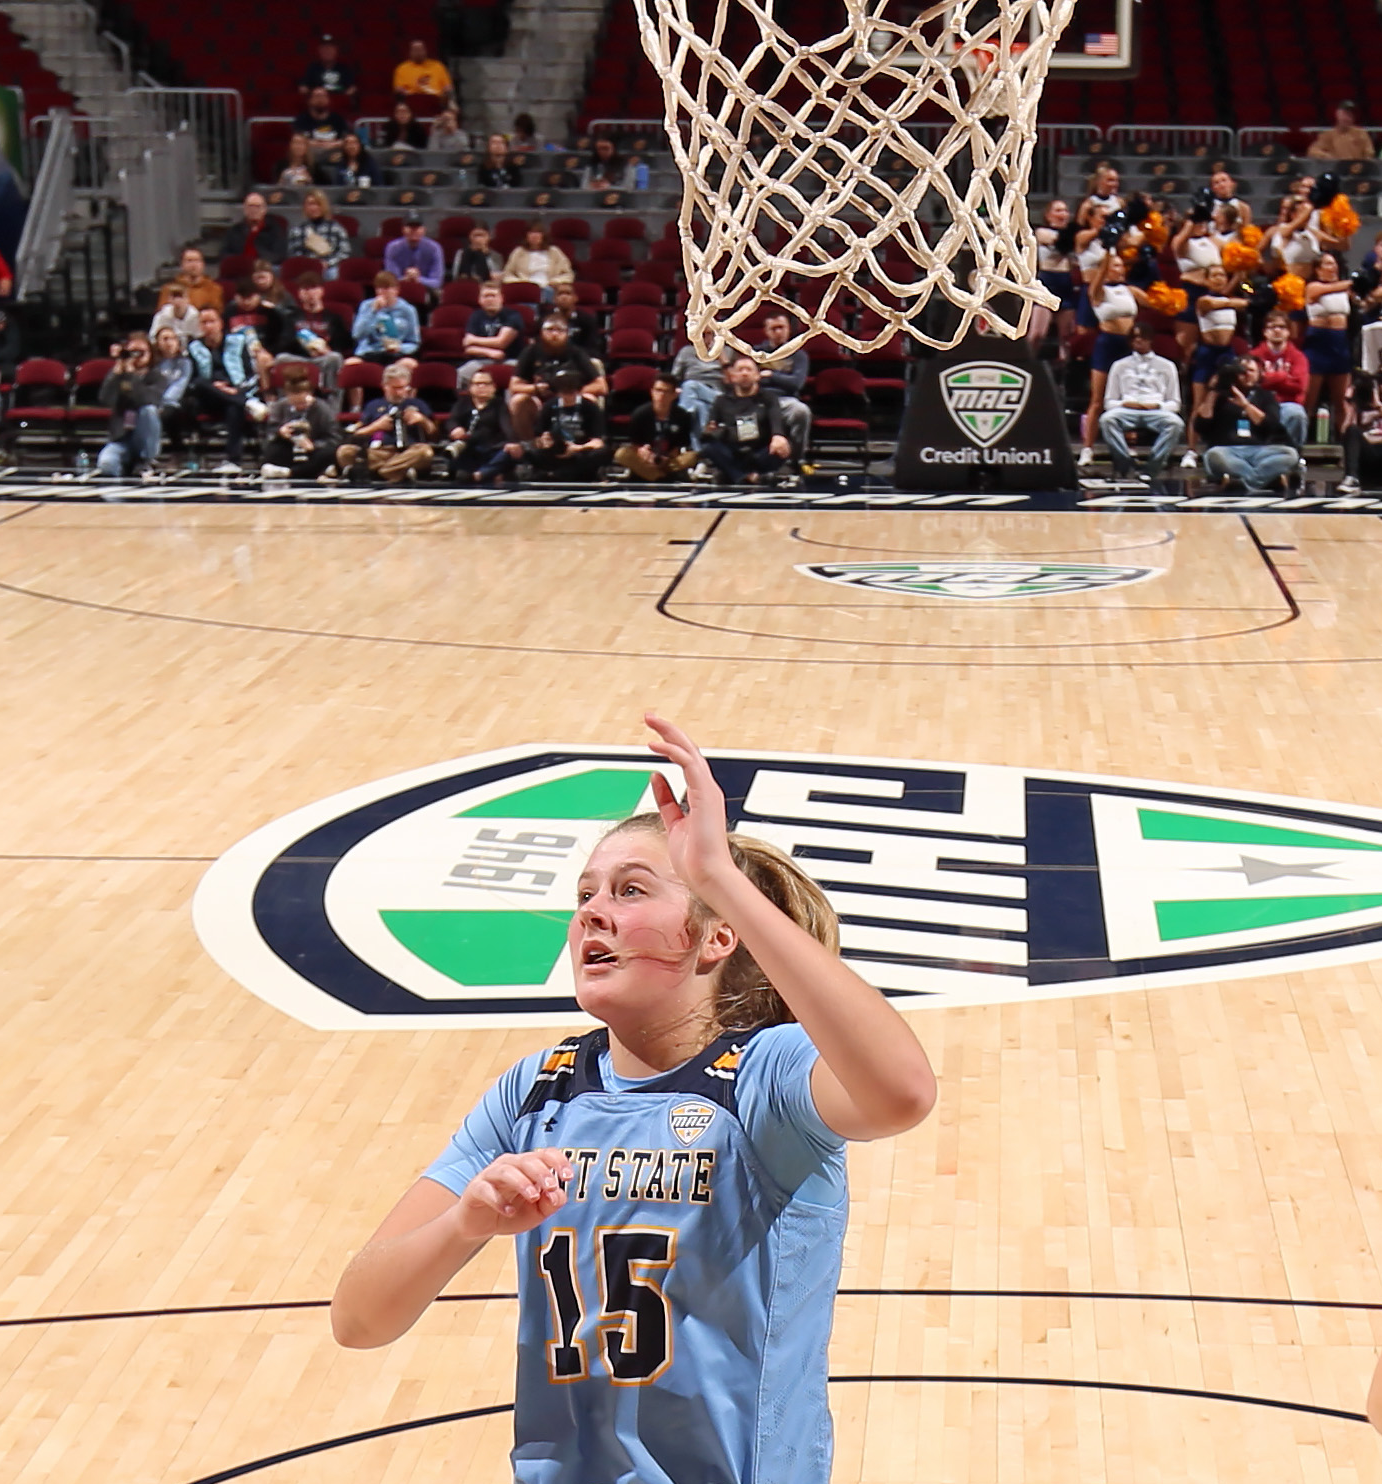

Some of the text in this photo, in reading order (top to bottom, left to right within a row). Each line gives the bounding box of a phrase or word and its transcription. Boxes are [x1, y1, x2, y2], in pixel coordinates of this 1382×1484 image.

[950, 389, 1023, 410] MAC
[919, 446, 981, 465] Credit
[442, 827, 578, 896] 1946
[672, 1115, 711, 1127] MAC
[602, 1148, 716, 1204] STATE
[537, 1225, 679, 1388] 15
